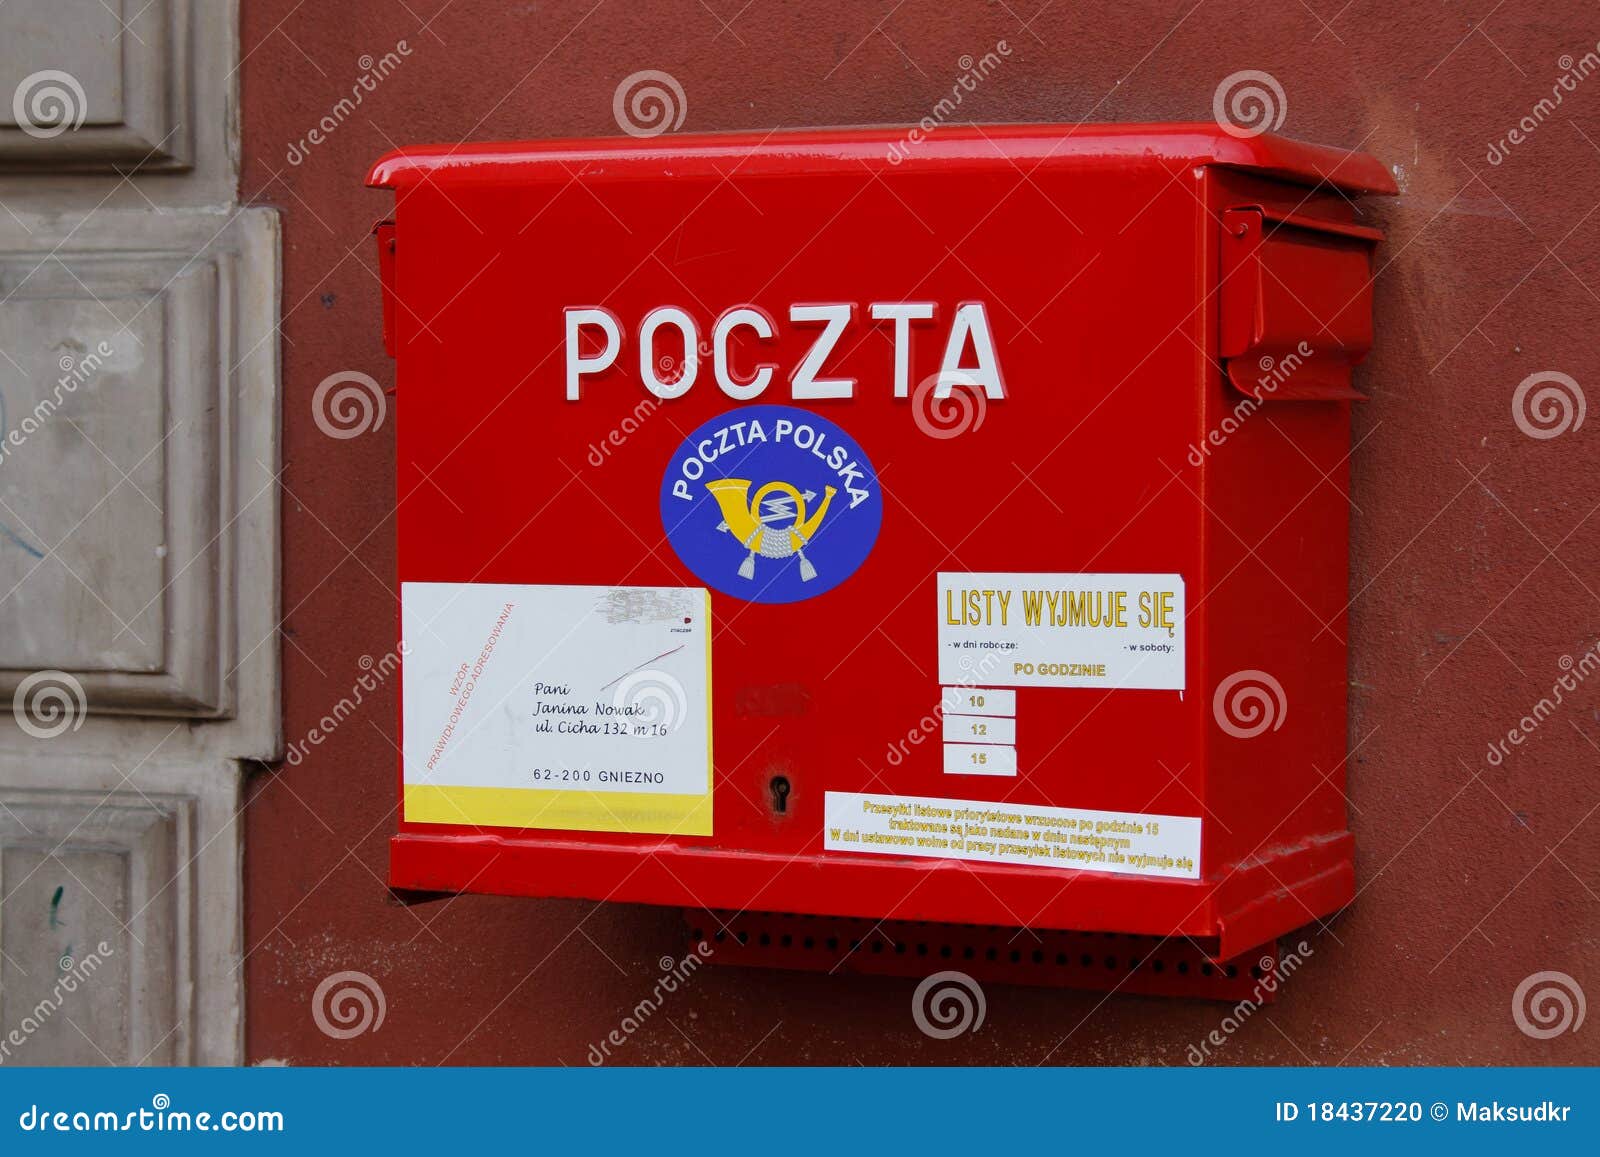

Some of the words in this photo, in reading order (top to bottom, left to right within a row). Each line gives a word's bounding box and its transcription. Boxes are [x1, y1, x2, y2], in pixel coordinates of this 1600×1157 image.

[564, 303, 1006, 401] POCZTA
[672, 419, 767, 501] POCZTA
[775, 419, 870, 509] POLSKA
[946, 589, 1012, 626] LISTY
[1022, 590, 1129, 628] WYJMUJE
[1138, 591, 1175, 638] SIĘ
[471, 601, 515, 682] ADRESOWANIA
[963, 640, 978, 649] dni
[1140, 644, 1175, 653] soboty:
[1013, 662, 1034, 675] PO
[1037, 663, 1106, 677] GODZINIE
[449, 661, 471, 697] WZÓR
[535, 682, 571, 695] Pani
[532, 701, 590, 717] Janina
[595, 702, 645, 716] Nowak
[968, 695, 985, 707] 10
[535, 720, 553, 733] ul.
[558, 720, 601, 734] Cicha
[603, 722, 628, 735] 132
[633, 726, 649, 735] m
[652, 723, 667, 736] 16
[971, 723, 987, 736] 12
[970, 752, 987, 765] 15
[533, 769, 591, 781] 62-200
[598, 770, 664, 784] GNIEZNO
[914, 804, 952, 819] listowe
[1024, 813, 1077, 828] wrzucone
[1079, 819, 1093, 832] po
[1096, 821, 1143, 835] godzinie
[1146, 822, 1160, 836] 15
[888, 817, 948, 833] traktowane
[965, 823, 988, 838] jako
[990, 826, 1030, 840] nadane
[1032, 830, 1041, 841] w
[1043, 829, 1068, 843] dniu
[830, 828, 841, 841] W
[843, 829, 860, 843] dni
[861, 832, 915, 847] ustawowo
[917, 835, 948, 849] wolne
[950, 838, 964, 850] od
[966, 840, 997, 855] pracy
[1053, 845, 1105, 864] listowych
[1108, 851, 1125, 864] nie
[1127, 853, 1174, 870] wyjmuje
